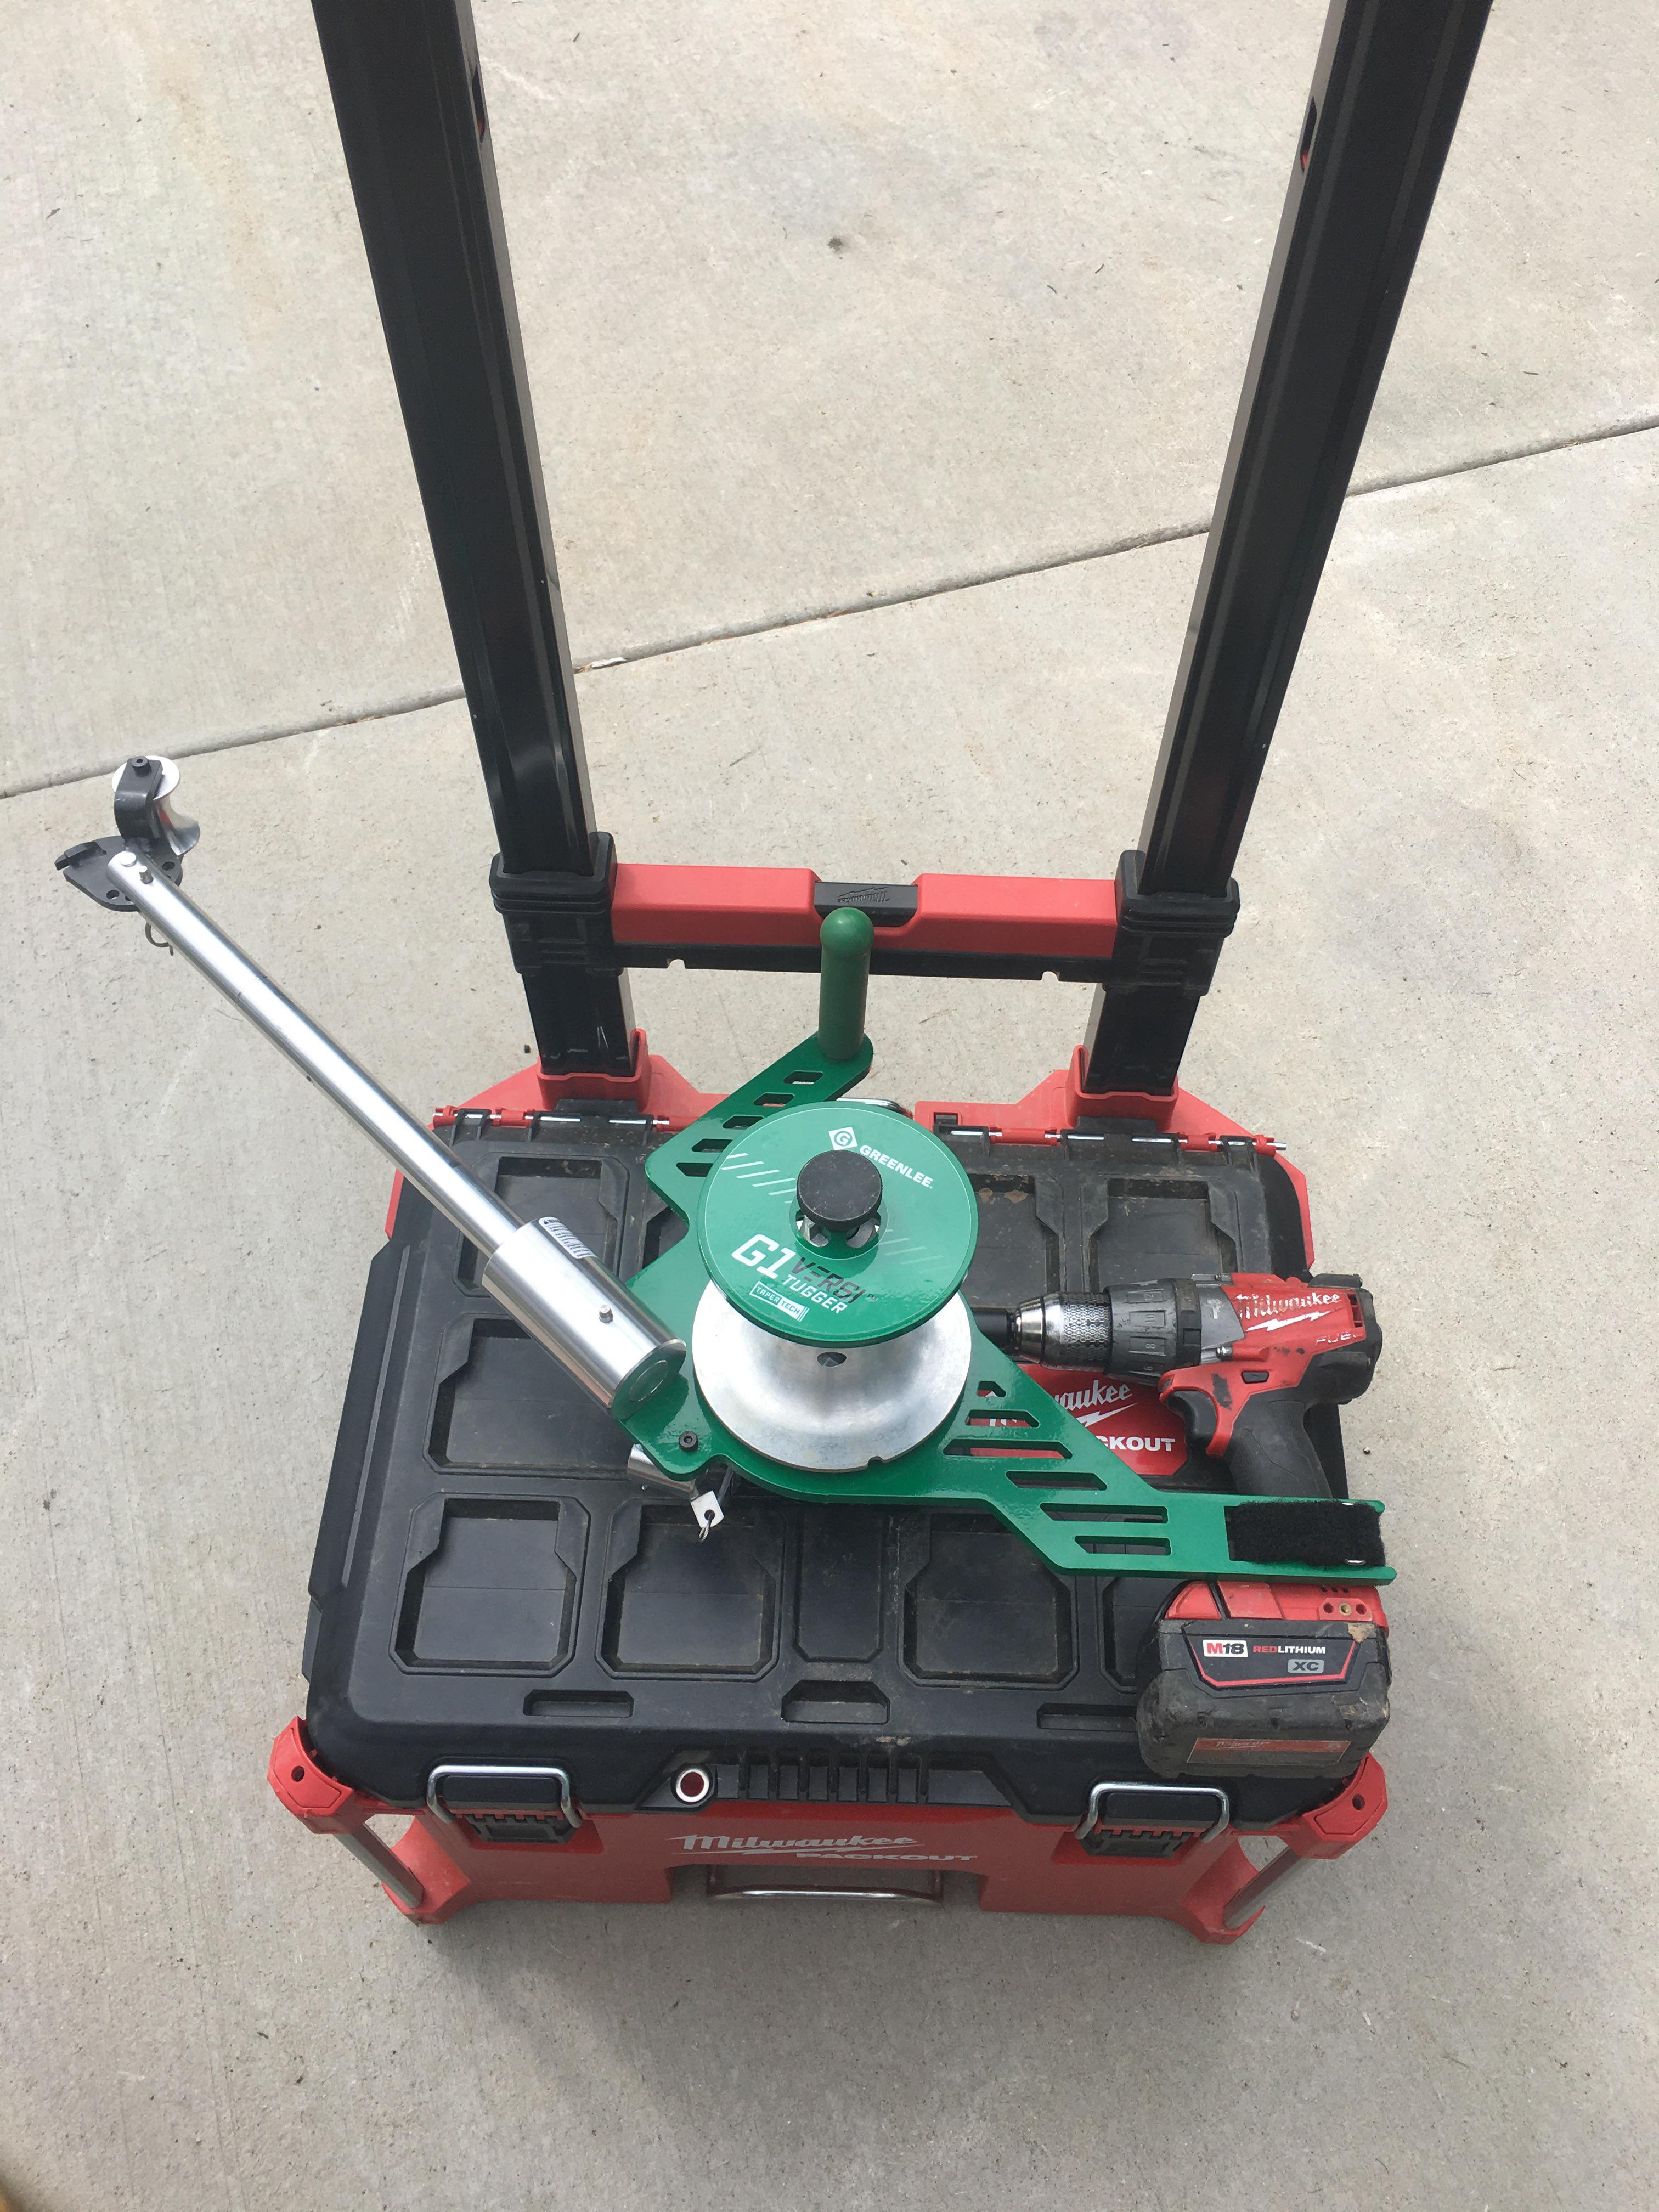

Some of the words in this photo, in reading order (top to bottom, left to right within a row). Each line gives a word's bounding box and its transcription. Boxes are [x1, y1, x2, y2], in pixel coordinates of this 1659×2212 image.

[860, 1145, 933, 1188] GREENLEE
[731, 1233, 796, 1279] G1
[756, 1286, 780, 1303] TAPER
[781, 1300, 801, 1314] TECH
[782, 1274, 848, 1314] TUGGER
[1235, 1292, 1342, 1319] Milwaukee
[1206, 1643, 1244, 1655] M18
[1293, 1661, 1319, 1671] XC
[665, 1835, 917, 1850] Milwaukee
[796, 1853, 978, 1861] PACKOUT
